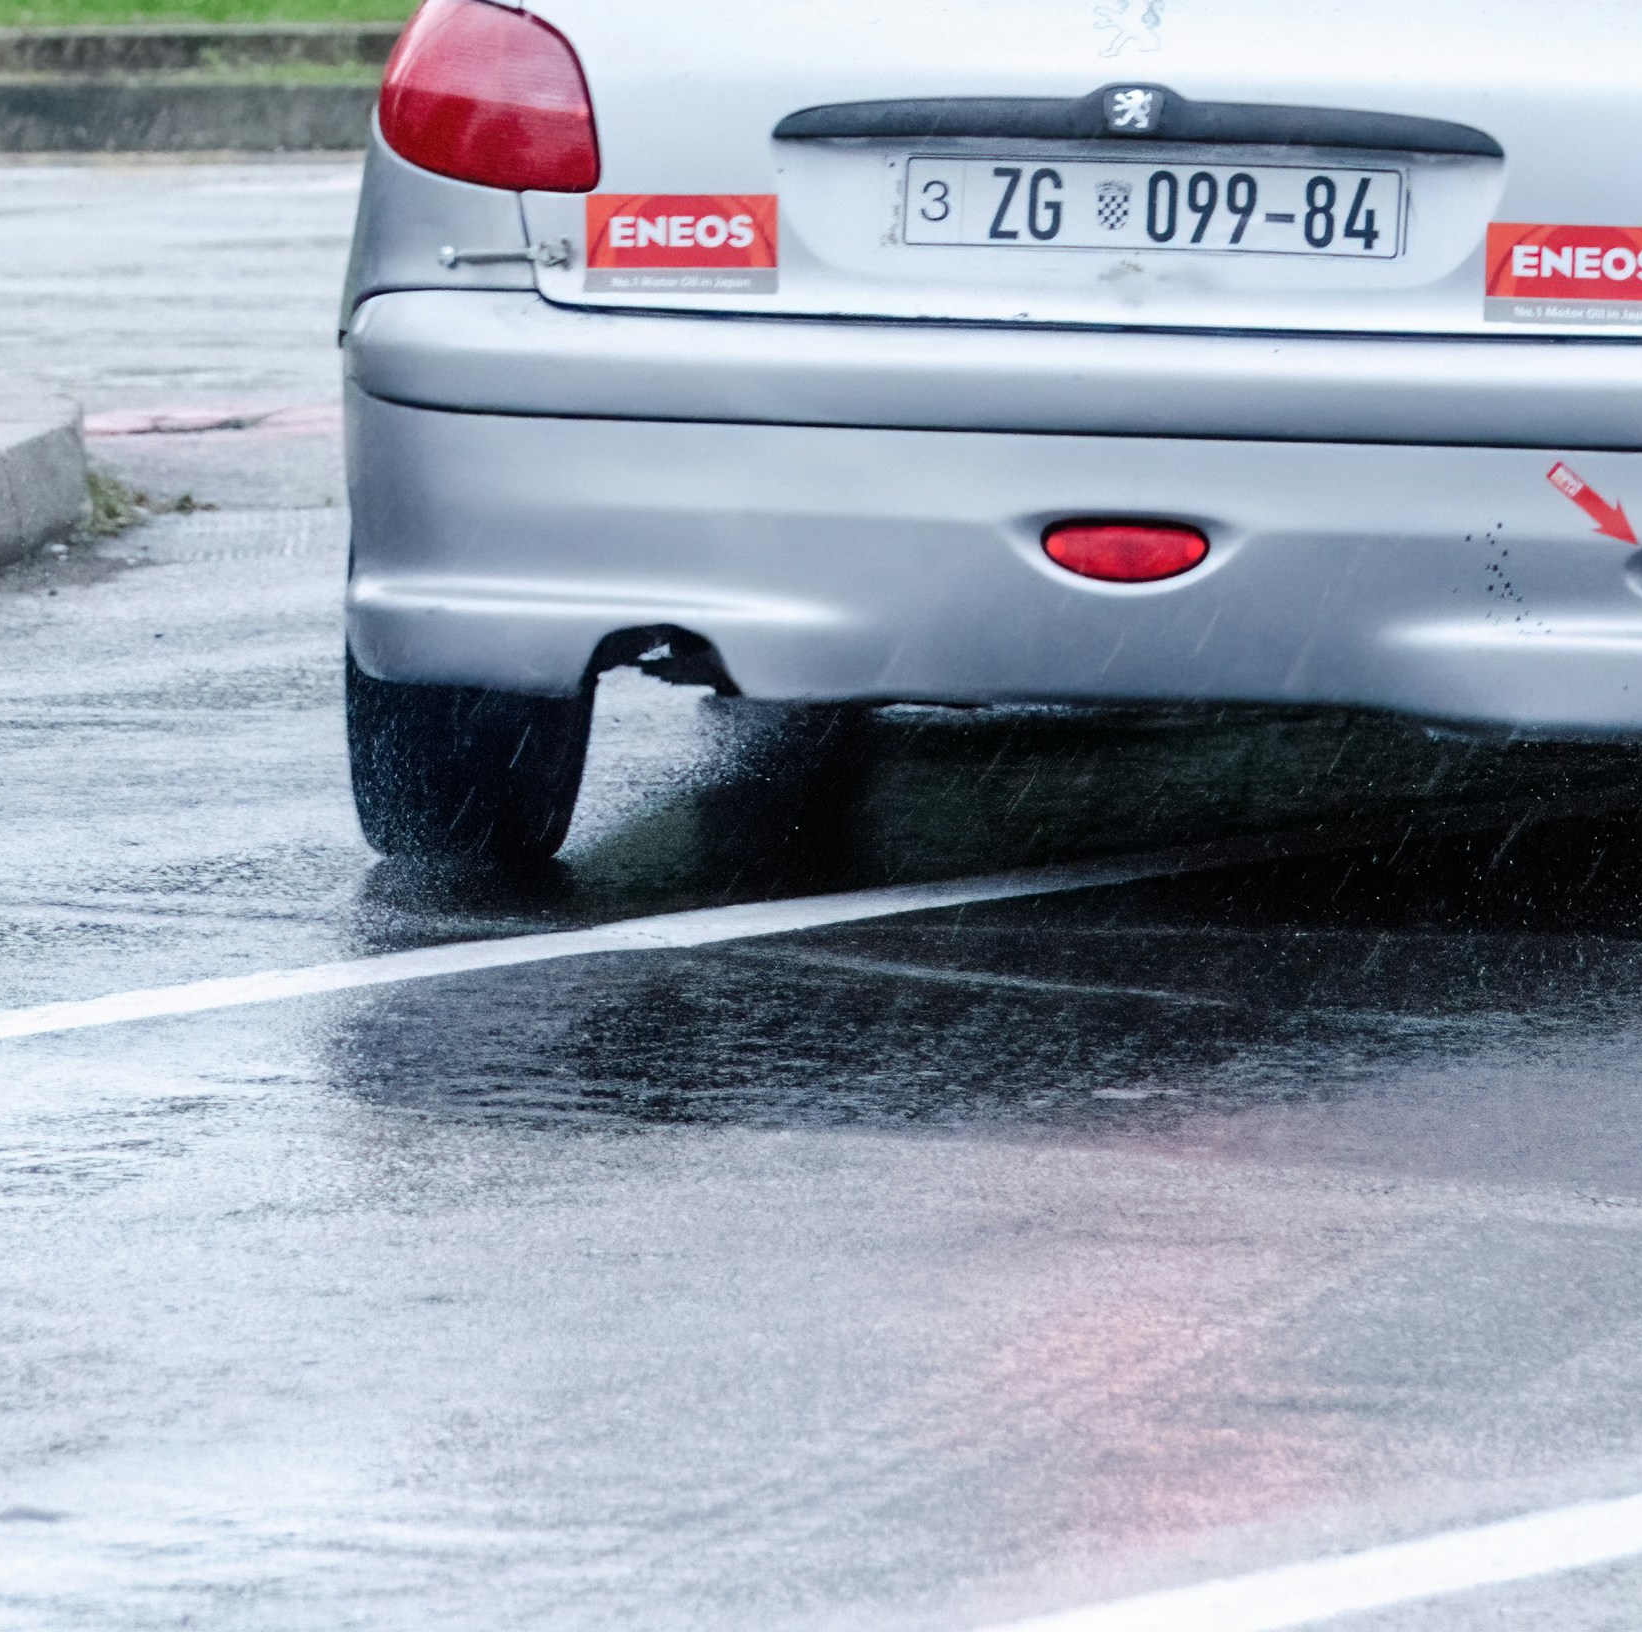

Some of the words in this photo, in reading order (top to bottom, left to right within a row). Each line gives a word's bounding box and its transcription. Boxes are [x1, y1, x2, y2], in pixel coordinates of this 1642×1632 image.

[609, 215, 755, 248] ENEOS
[920, 180, 951, 222] 3
[988, 167, 1063, 242] ZG
[1146, 170, 1379, 250] 099-84
